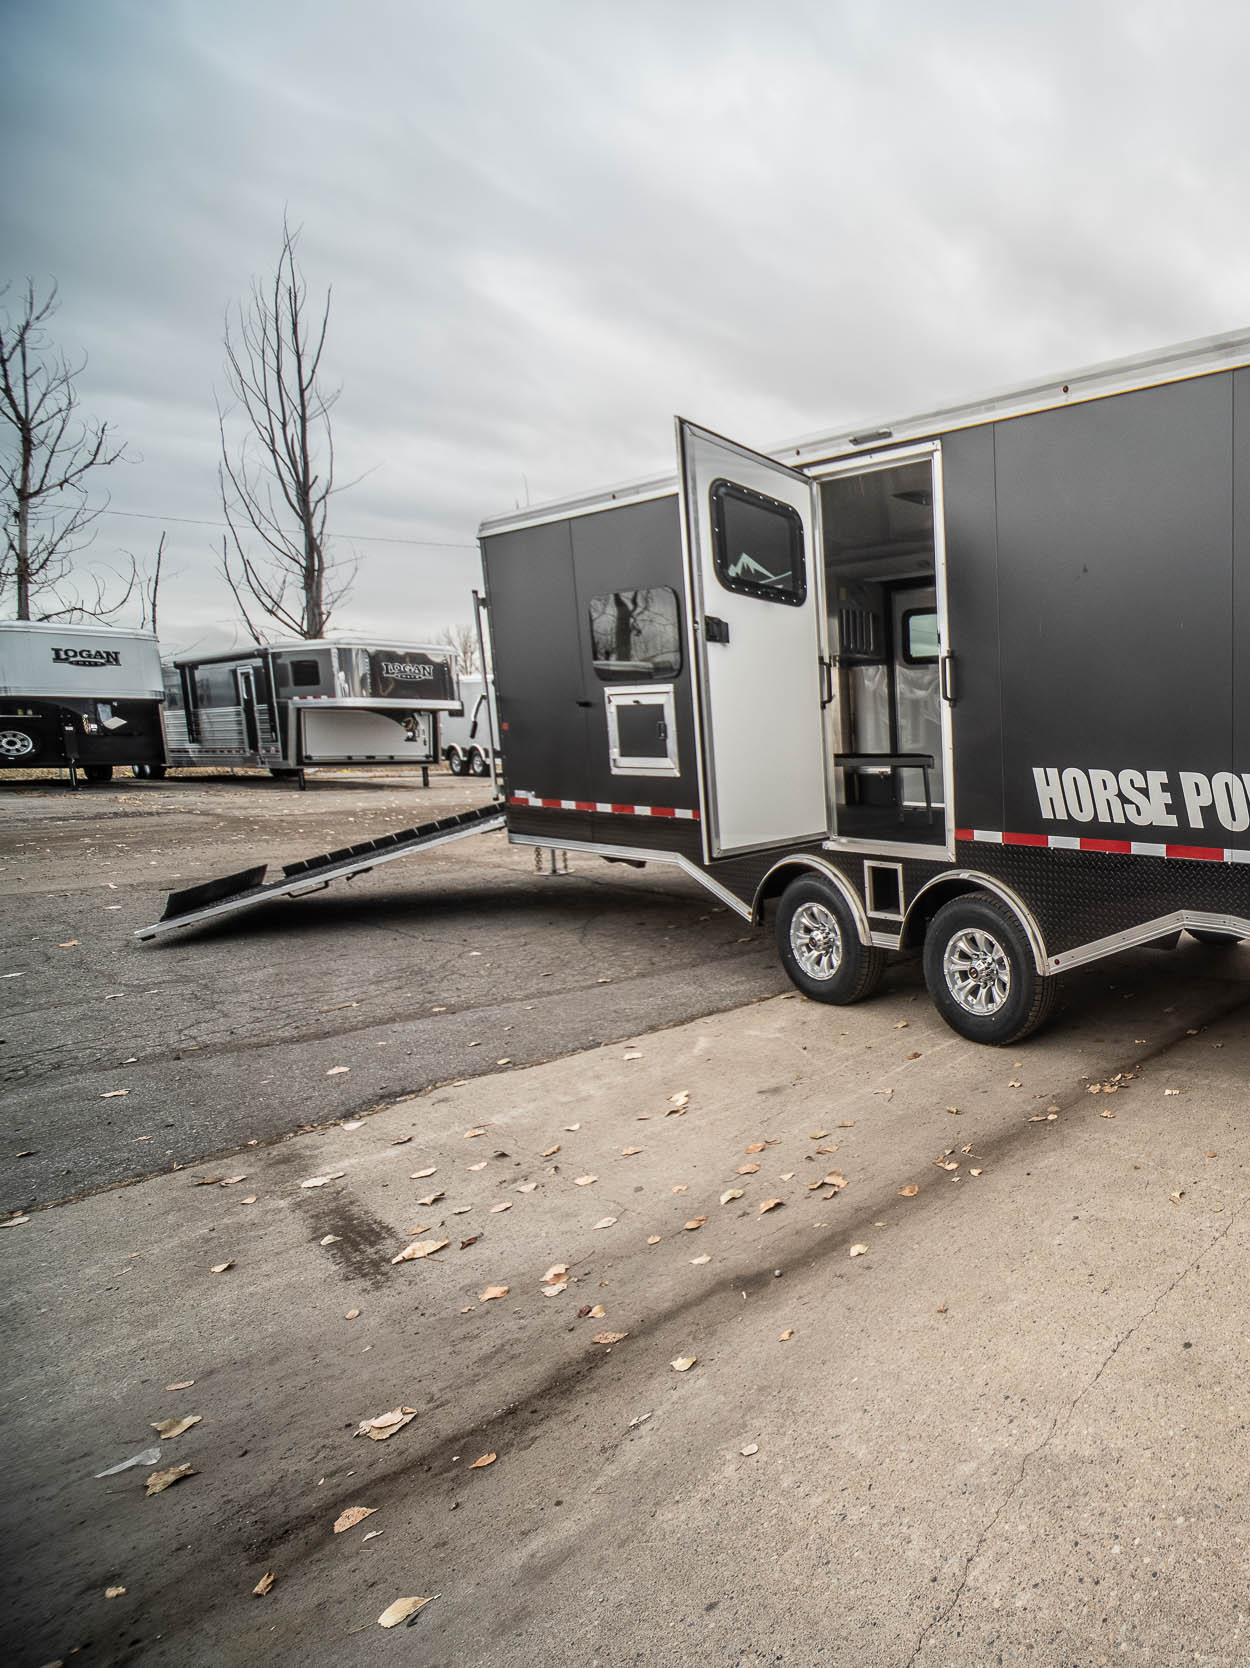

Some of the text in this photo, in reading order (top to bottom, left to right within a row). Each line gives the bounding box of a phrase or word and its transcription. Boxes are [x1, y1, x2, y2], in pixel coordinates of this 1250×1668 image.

[51, 647, 121, 666] LOGAN
[382, 661, 433, 679] LOGAN
[1032, 767, 1178, 827] HORSE
